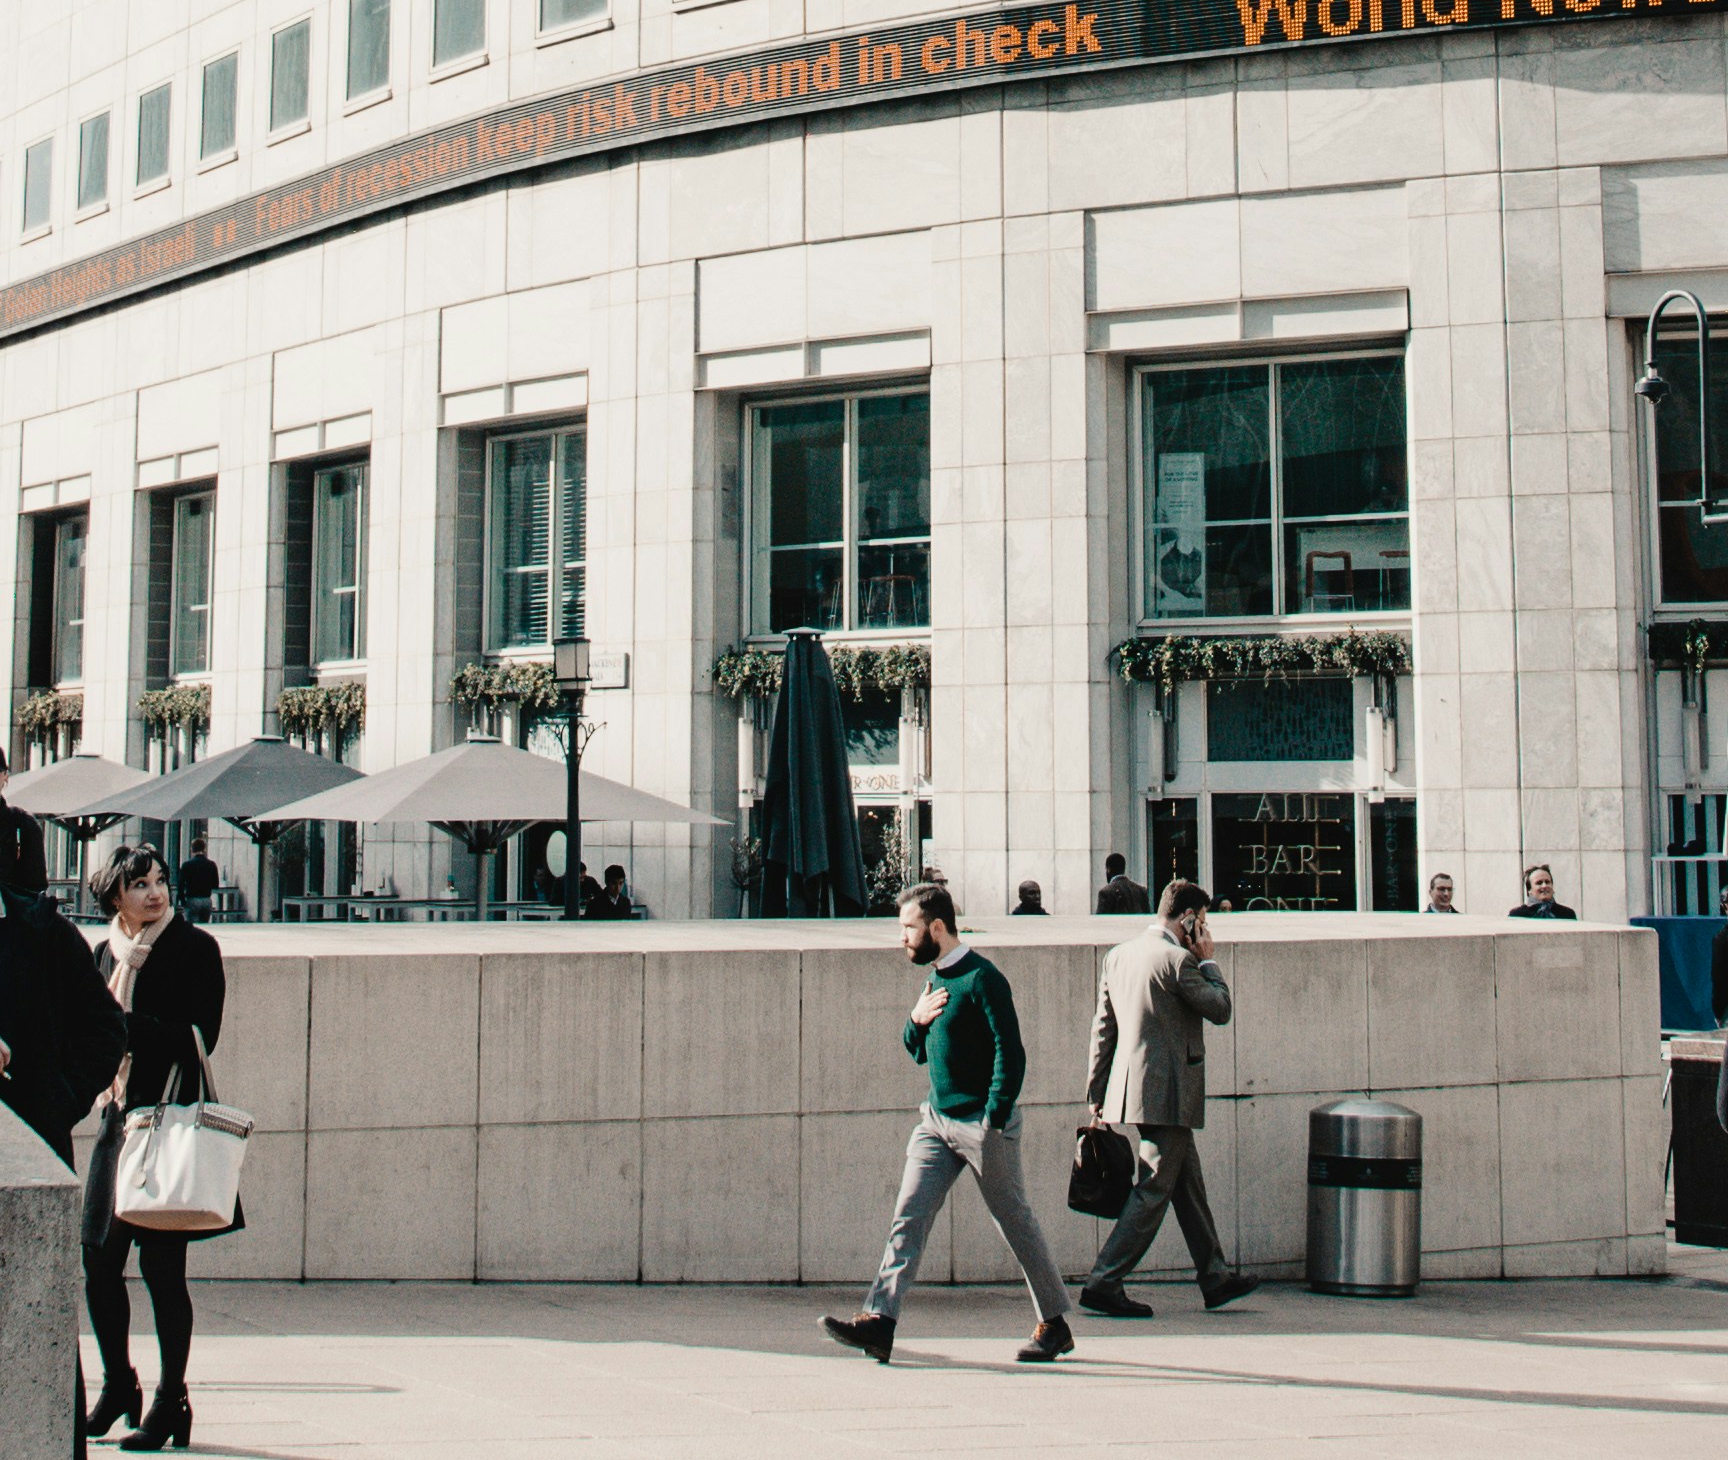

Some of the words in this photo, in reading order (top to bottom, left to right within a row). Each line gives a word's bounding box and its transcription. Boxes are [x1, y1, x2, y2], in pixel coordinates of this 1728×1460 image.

[255, 188, 314, 236] Fears
[320, 167, 343, 214] of
[346, 137, 469, 204] recession
[476, 111, 557, 164] keep
[567, 83, 638, 141] risk
[649, 42, 842, 122] rebound
[858, 36, 903, 86] in
[921, 4, 1103, 75] check
[1253, 792, 1319, 822] ALL
[1249, 843, 1324, 875] BAR
